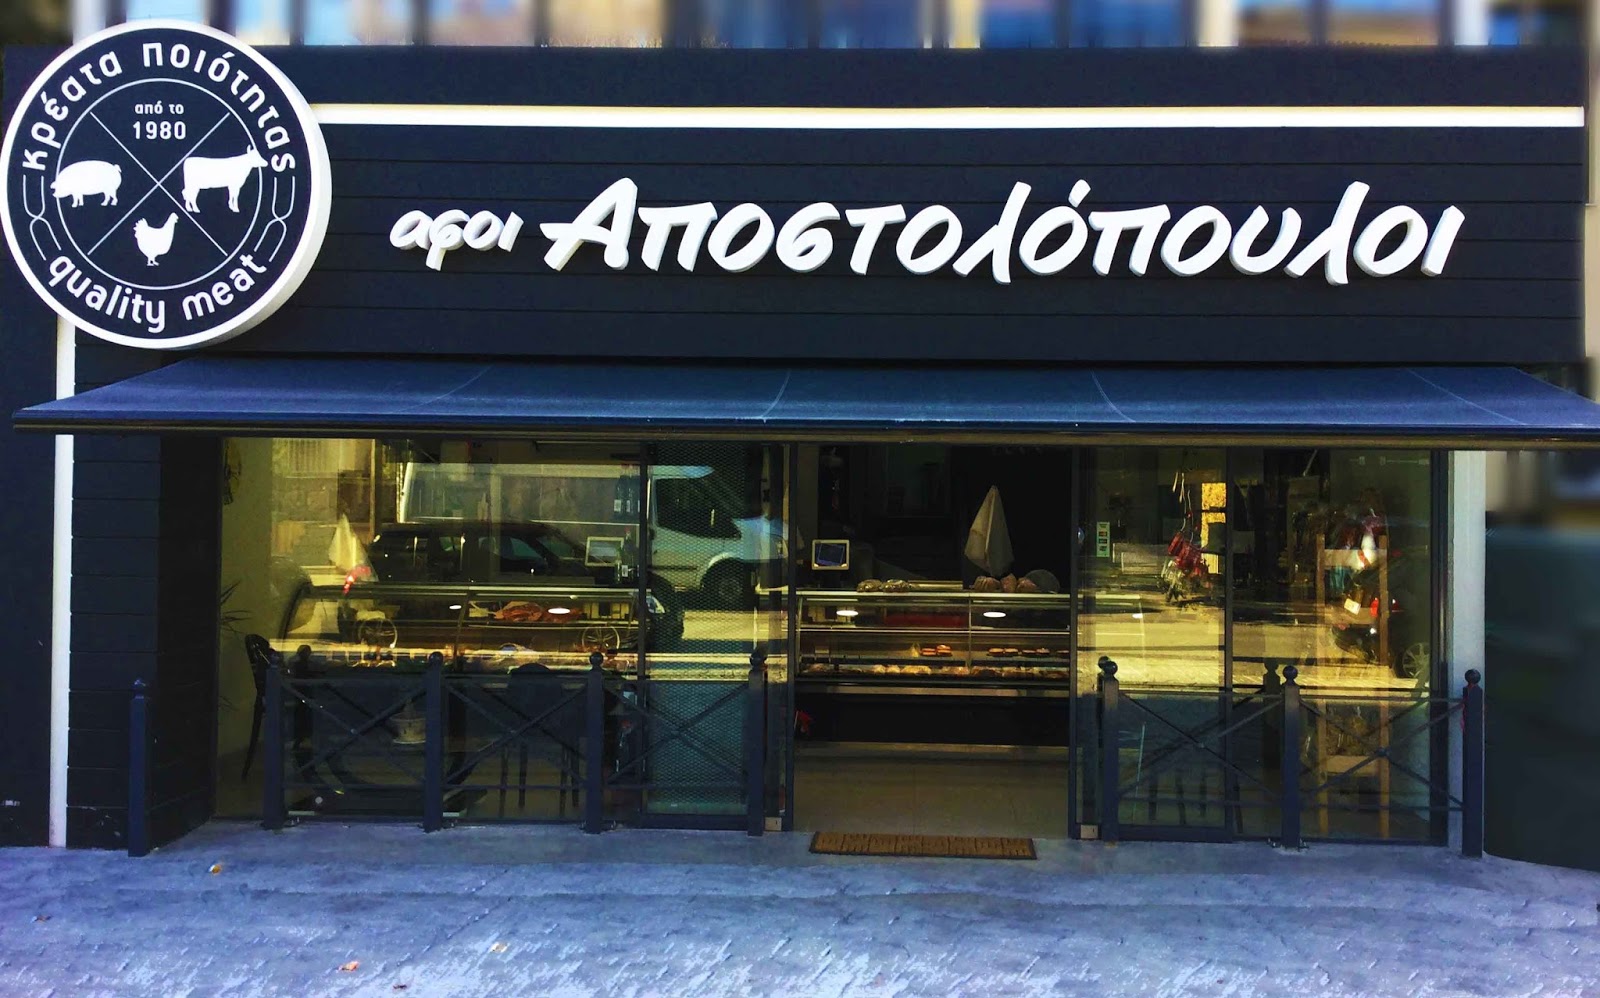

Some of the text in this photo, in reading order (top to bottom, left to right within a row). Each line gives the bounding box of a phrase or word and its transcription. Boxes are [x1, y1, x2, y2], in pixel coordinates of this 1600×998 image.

[134, 100, 185, 115] από το
[132, 121, 187, 140] 1980
[48, 253, 267, 334] quality meat
